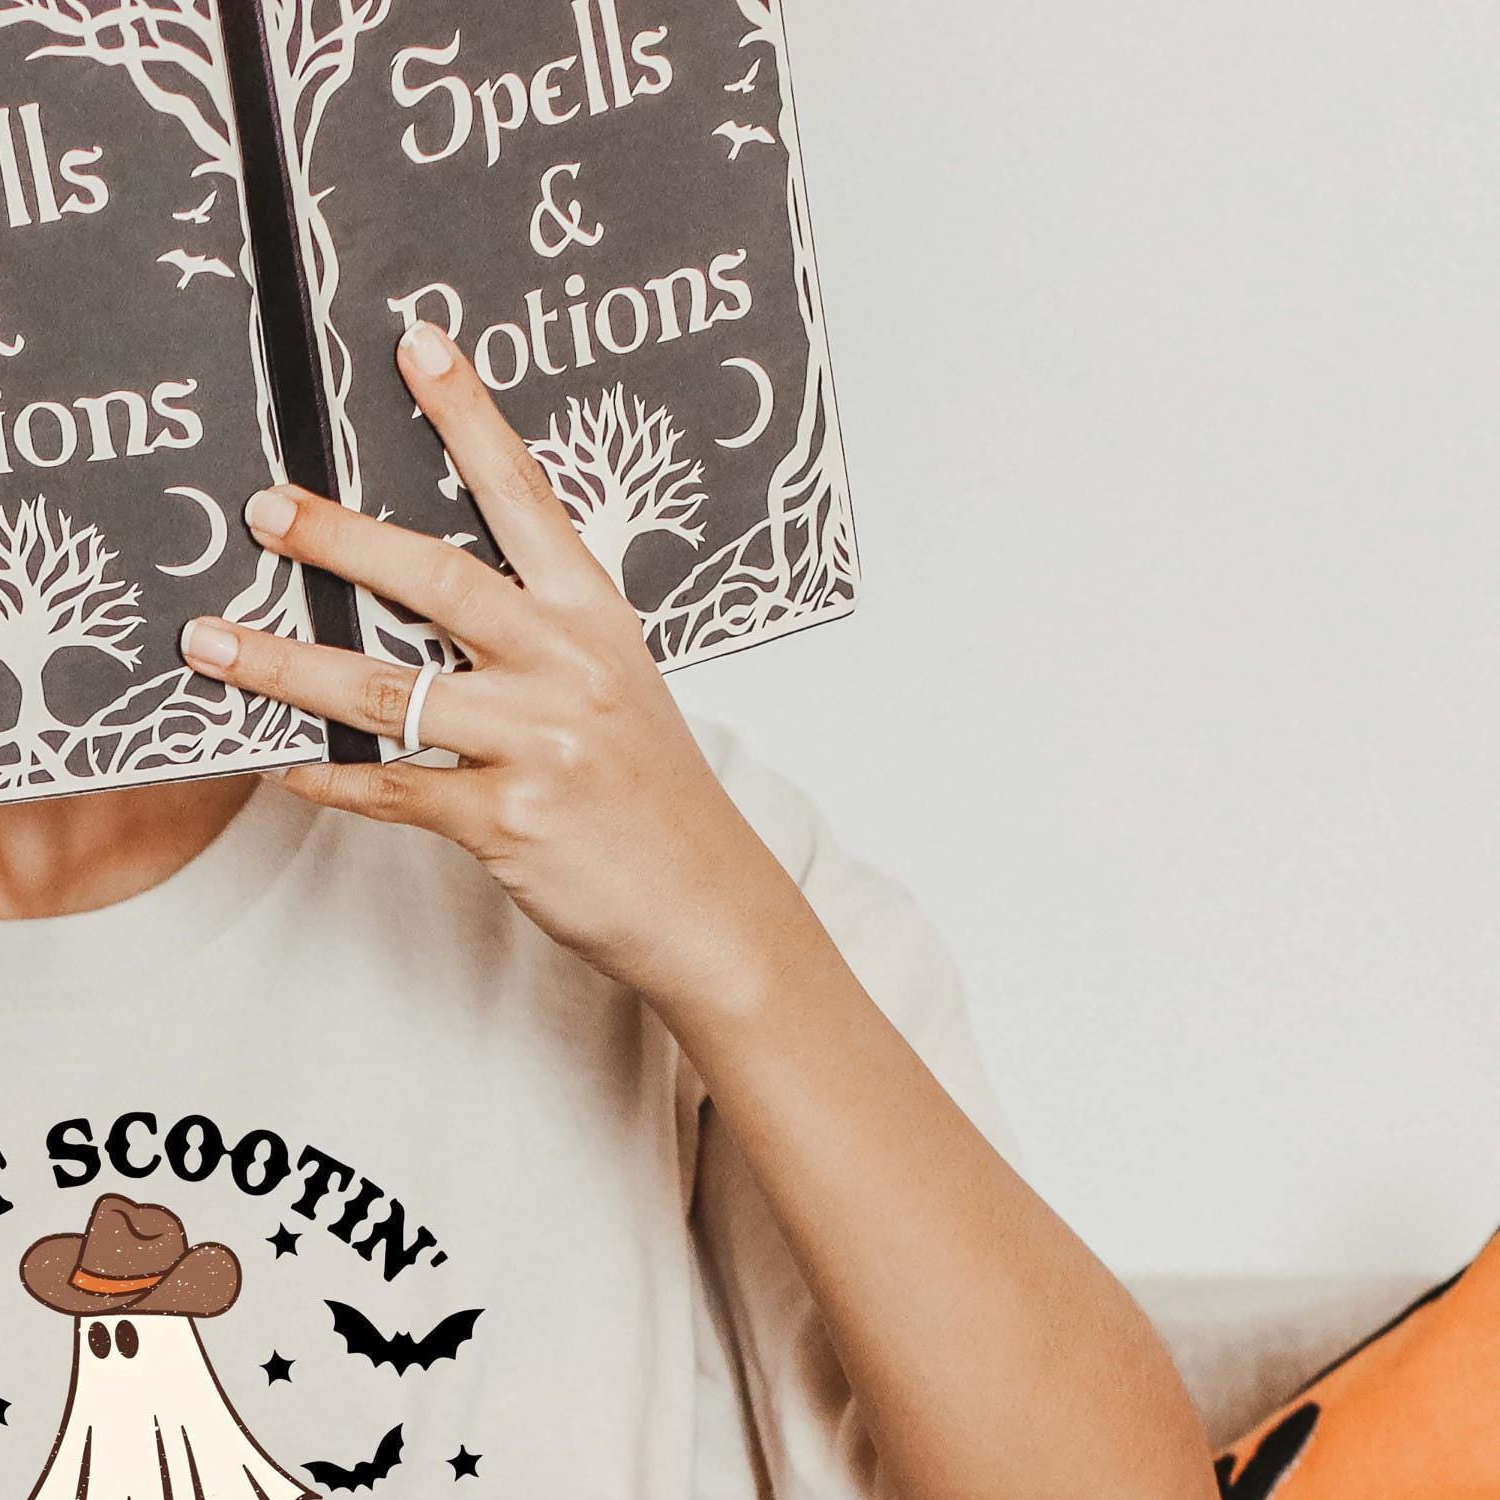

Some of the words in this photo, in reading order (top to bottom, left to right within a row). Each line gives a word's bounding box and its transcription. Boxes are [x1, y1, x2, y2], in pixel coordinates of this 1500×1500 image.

[389, 0, 673, 168] Spells
[529, 162, 605, 258] &
[46, 1111, 448, 1283] SCOOTIN'
